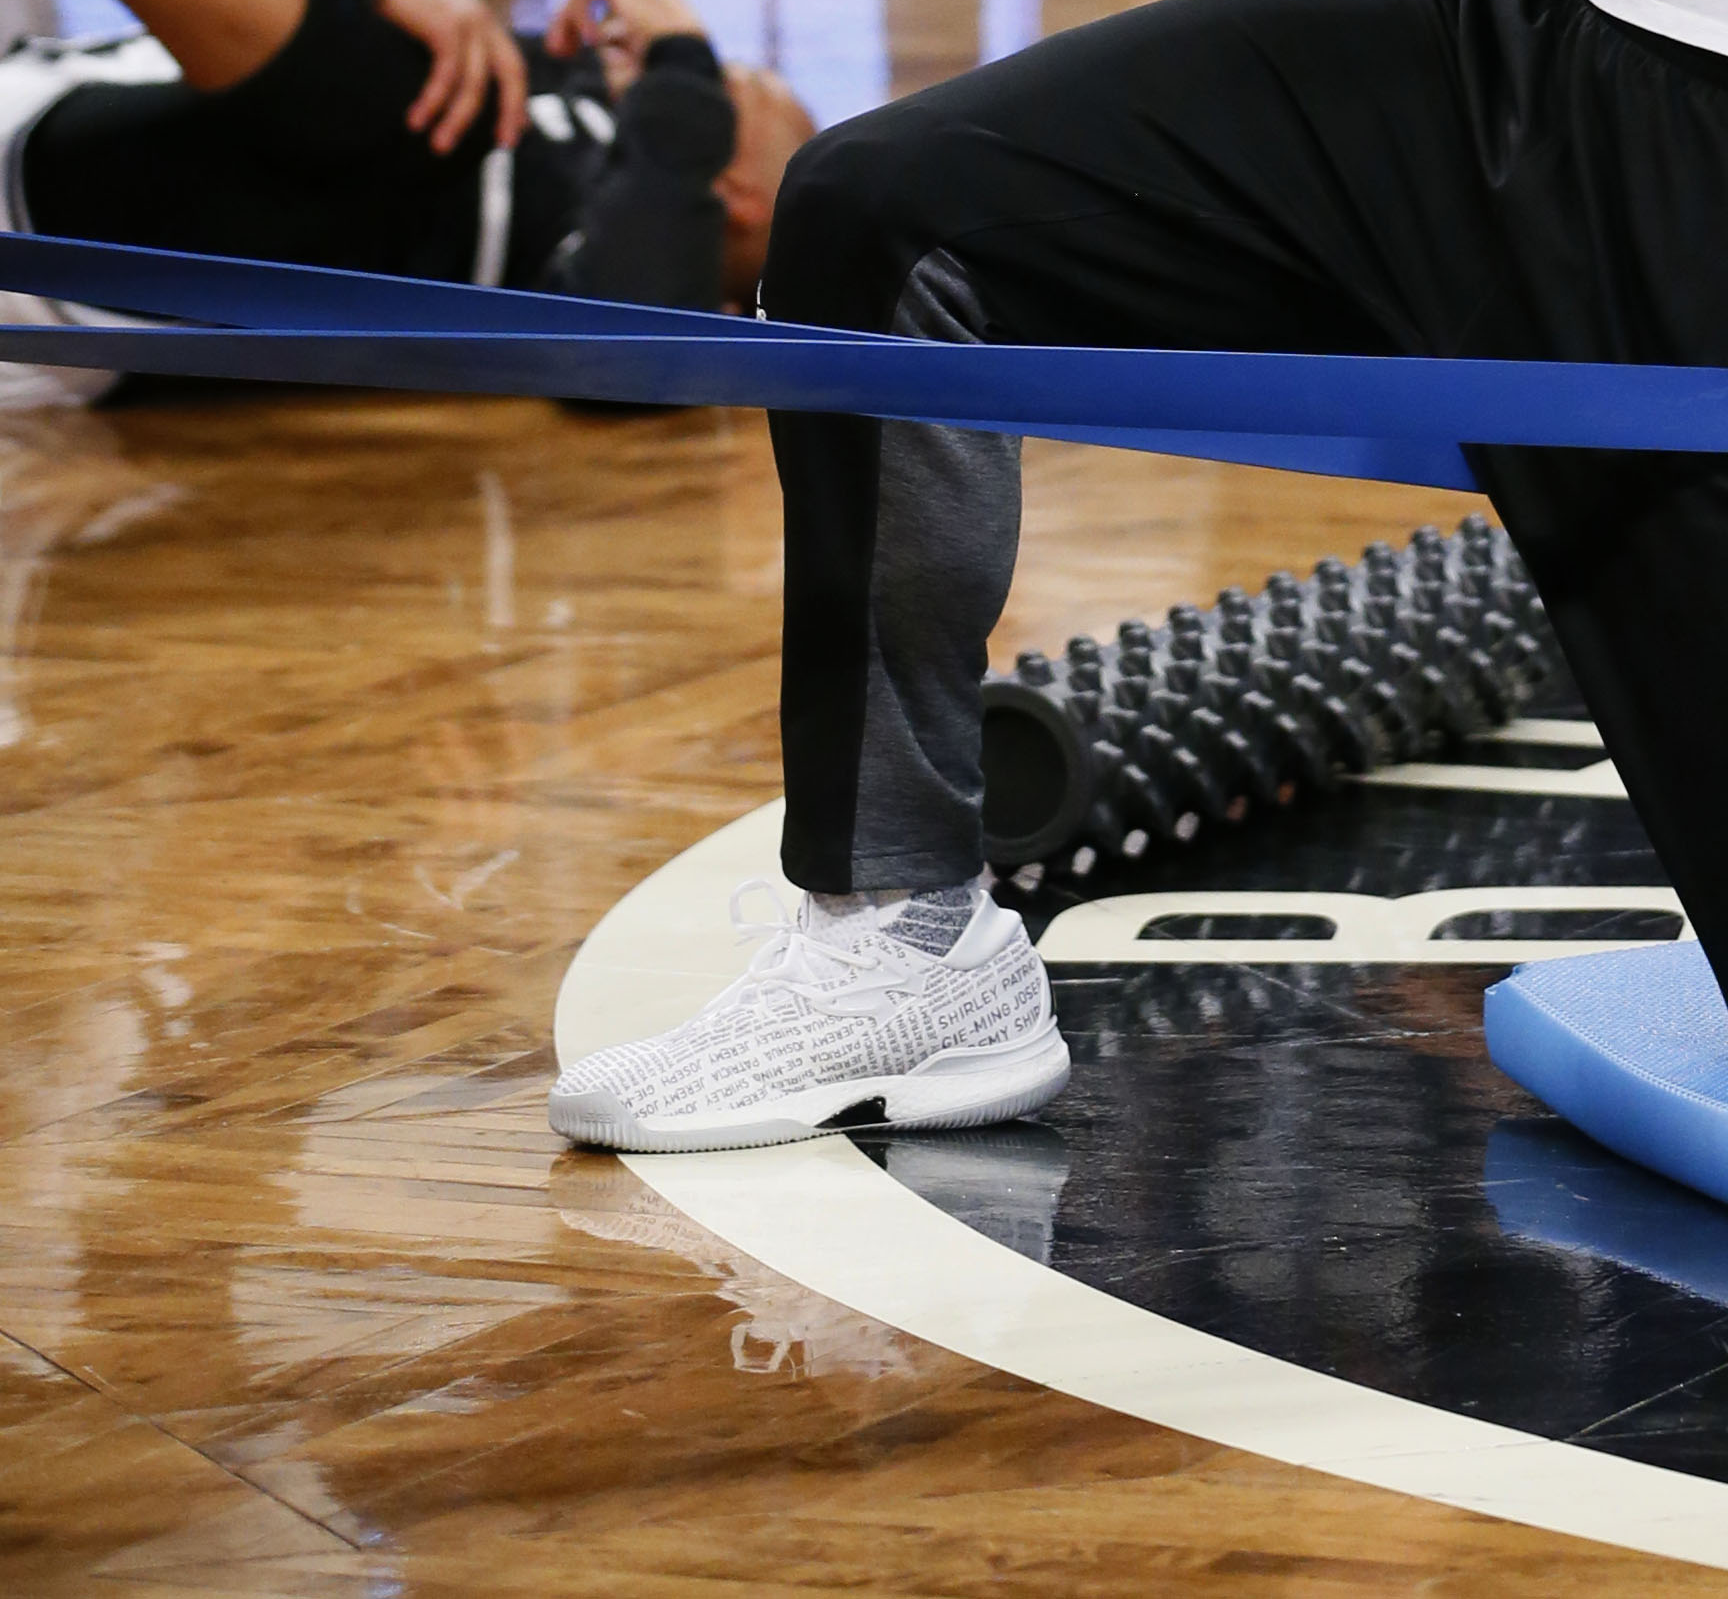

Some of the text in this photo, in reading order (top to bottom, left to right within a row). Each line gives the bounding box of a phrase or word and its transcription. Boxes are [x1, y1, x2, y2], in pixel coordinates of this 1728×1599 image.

[938, 984, 999, 1031] SHIRLEY
[812, 1023, 855, 1049] JEREMY
[941, 1001, 1011, 1049] GIE-MING
[709, 1041, 750, 1063] JEREMY
[763, 1041, 805, 1061] JOSHUA
[809, 1041, 861, 1063] PATRICIA
[820, 1054, 862, 1074] JEREMY
[660, 1059, 701, 1086] JOSEPH
[710, 1057, 760, 1082] PATRICIA
[663, 1076, 705, 1107] JEREMY
[706, 1078, 750, 1106] SHIRLEY
